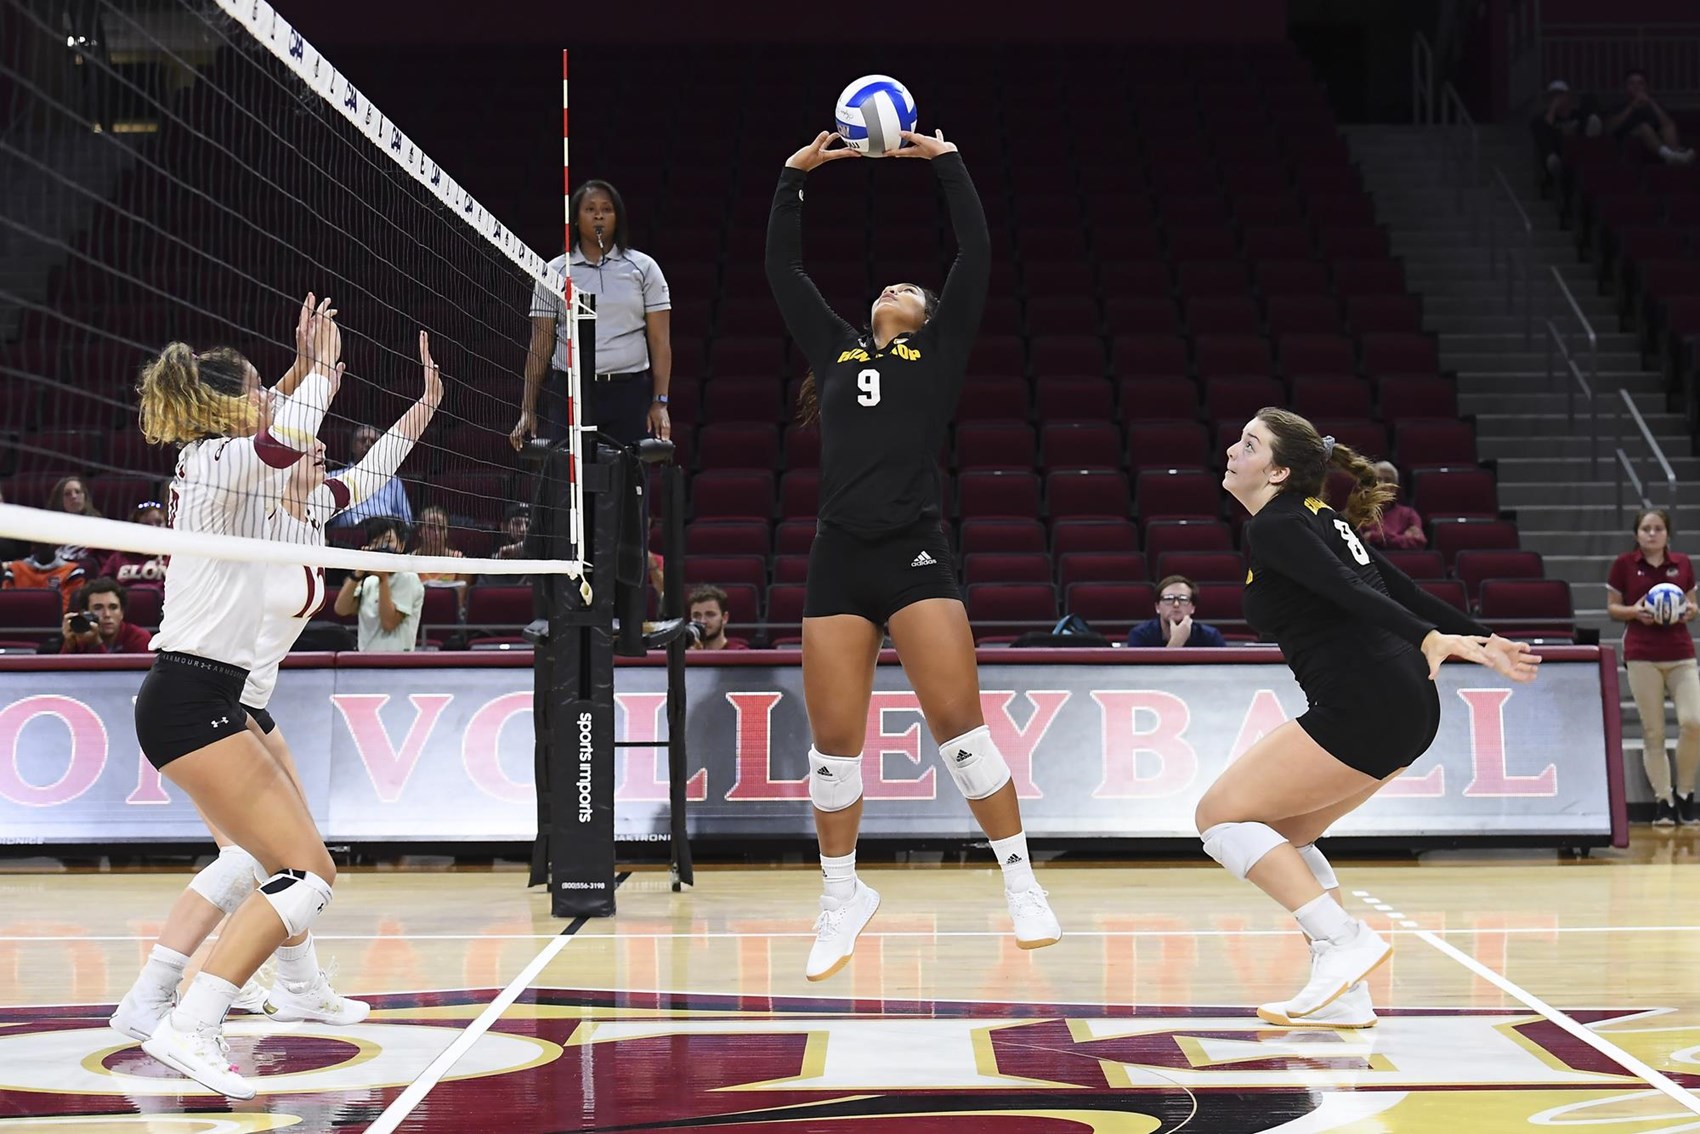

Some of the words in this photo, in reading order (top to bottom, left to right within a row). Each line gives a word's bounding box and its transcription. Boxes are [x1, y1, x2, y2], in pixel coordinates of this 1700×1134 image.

[857, 368, 881, 407] 9
[910, 558, 938, 568] adidas
[330, 689, 1559, 804] VOLLEYBL
[577, 712, 593, 761] sports
[576, 763, 593, 823] imports
[614, 833, 671, 842] AKTRONI
